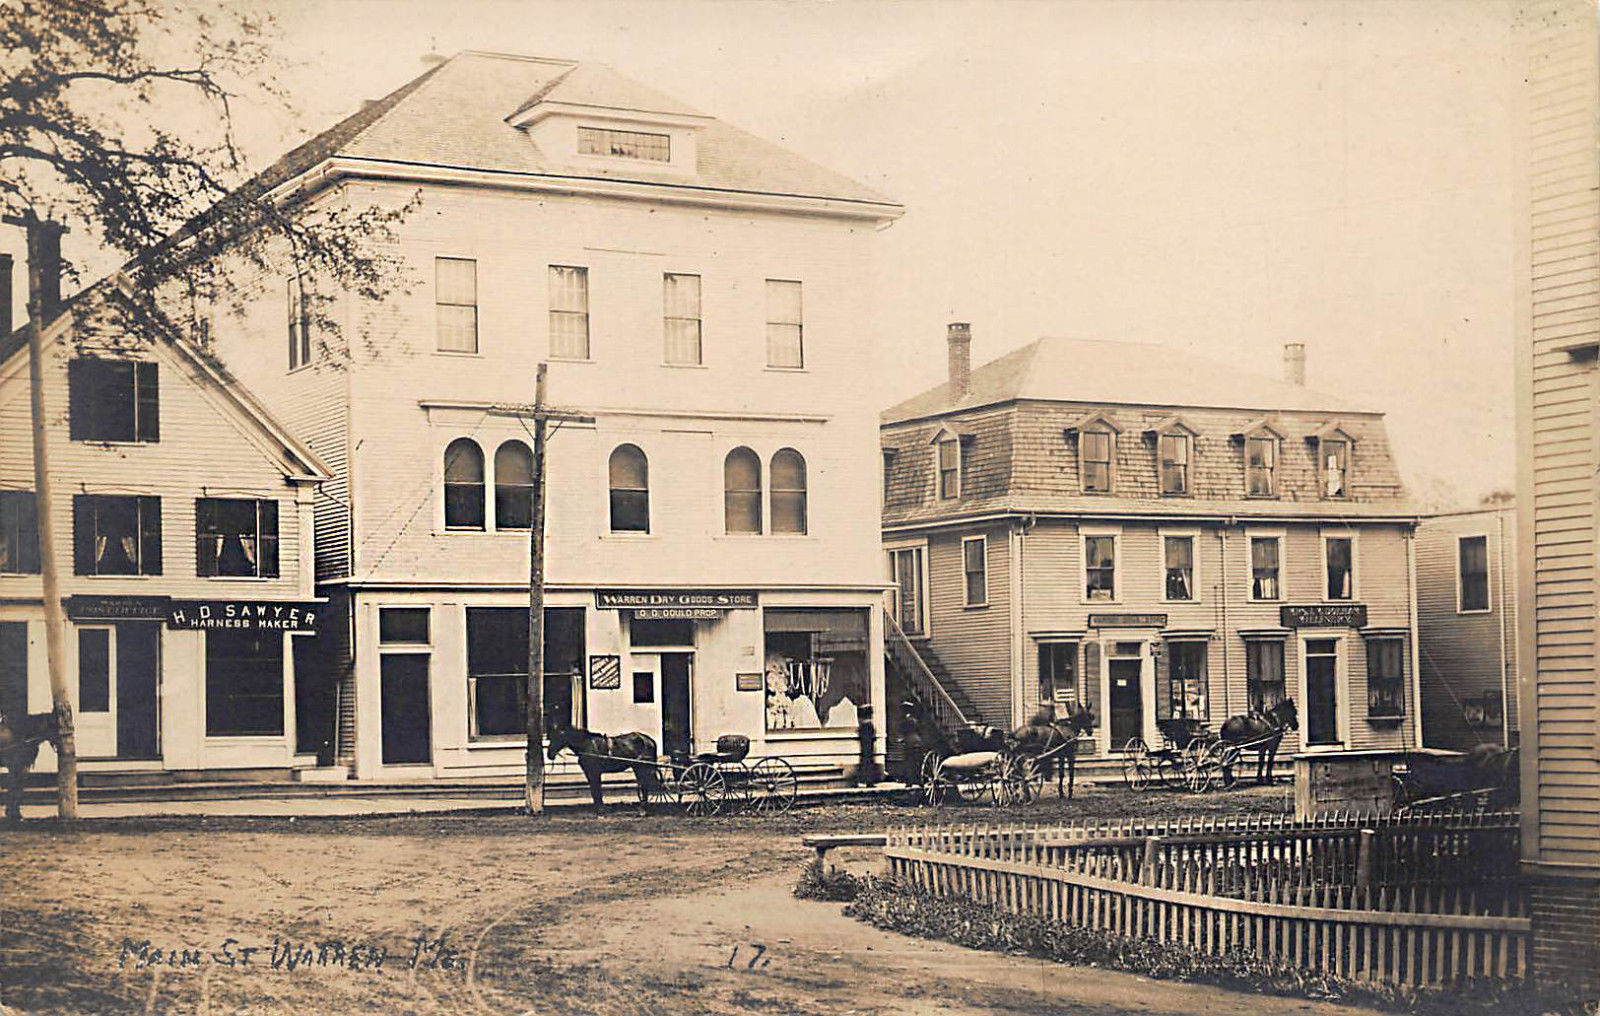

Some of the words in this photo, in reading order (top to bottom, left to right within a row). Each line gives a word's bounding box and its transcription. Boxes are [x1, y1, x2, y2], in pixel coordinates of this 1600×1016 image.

[603, 595, 647, 604] WARREN
[651, 595, 675, 604] DRY
[679, 595, 714, 604] GOODS
[717, 595, 752, 604] STORE
[173, 610, 186, 624] H
[200, 606, 210, 619] D
[225, 605, 316, 625] SAWYER
[191, 619, 250, 628] HARNESS
[258, 620, 298, 629] MAKER
